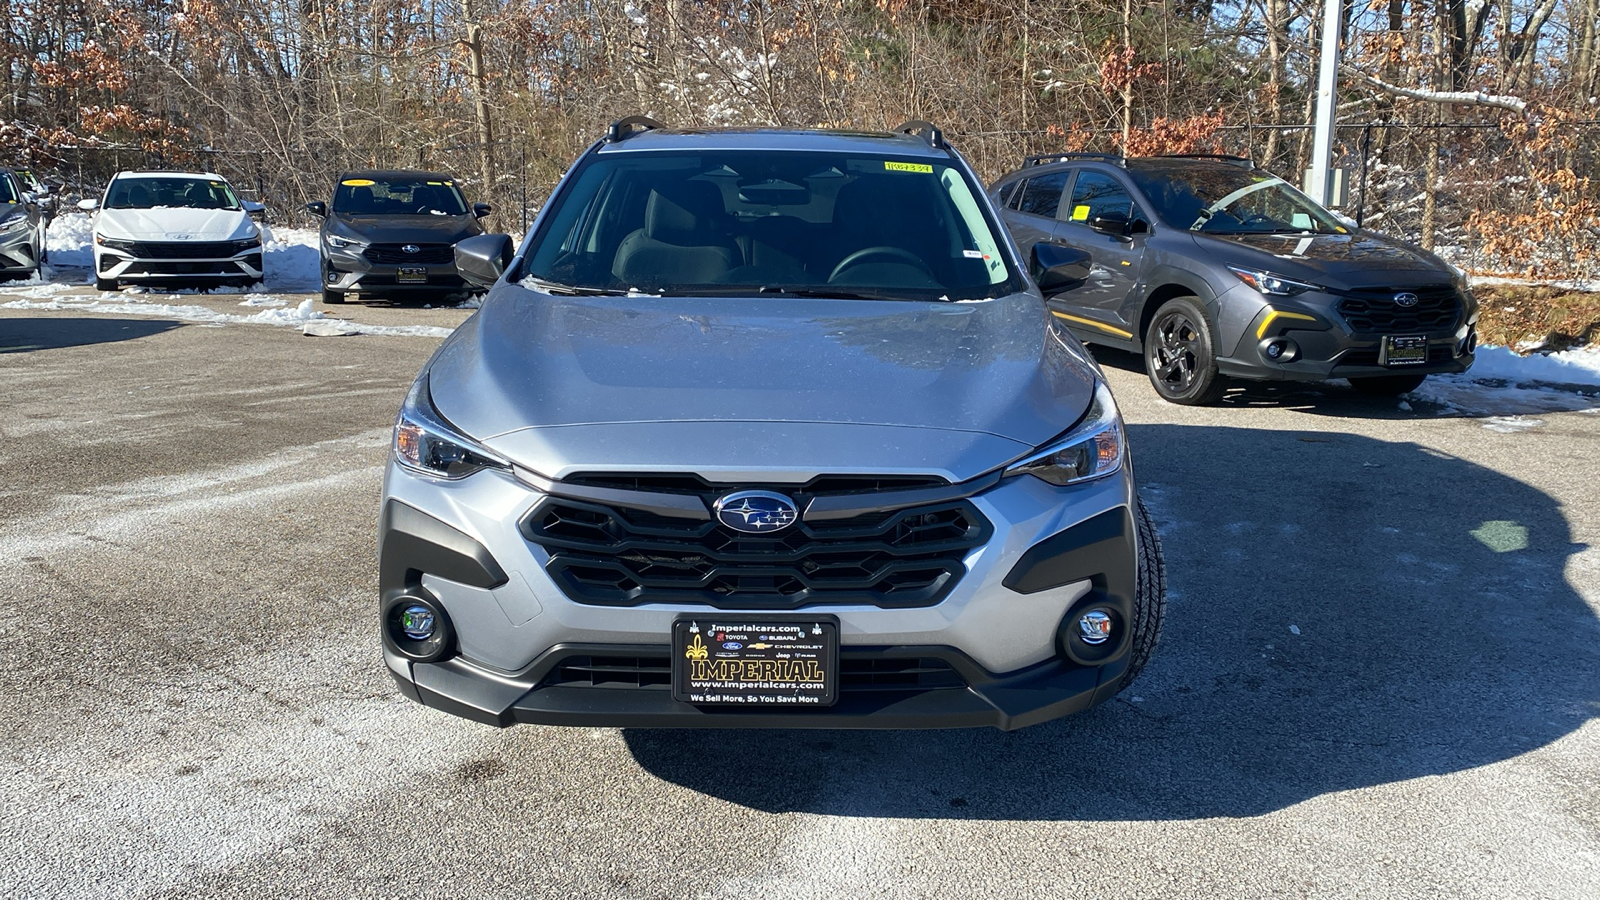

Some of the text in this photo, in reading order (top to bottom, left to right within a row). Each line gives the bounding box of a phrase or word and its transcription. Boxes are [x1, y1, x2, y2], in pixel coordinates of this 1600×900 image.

[711, 624, 801, 633] Imperialcars.com
[724, 642, 741, 650] Ford
[691, 659, 824, 683] IMPERIAL
[690, 694, 704, 702] We
[705, 694, 721, 702] Sell
[722, 694, 746, 703] More,
[747, 695, 758, 703] So
[760, 695, 776, 703] You
[777, 695, 797, 703] Save
